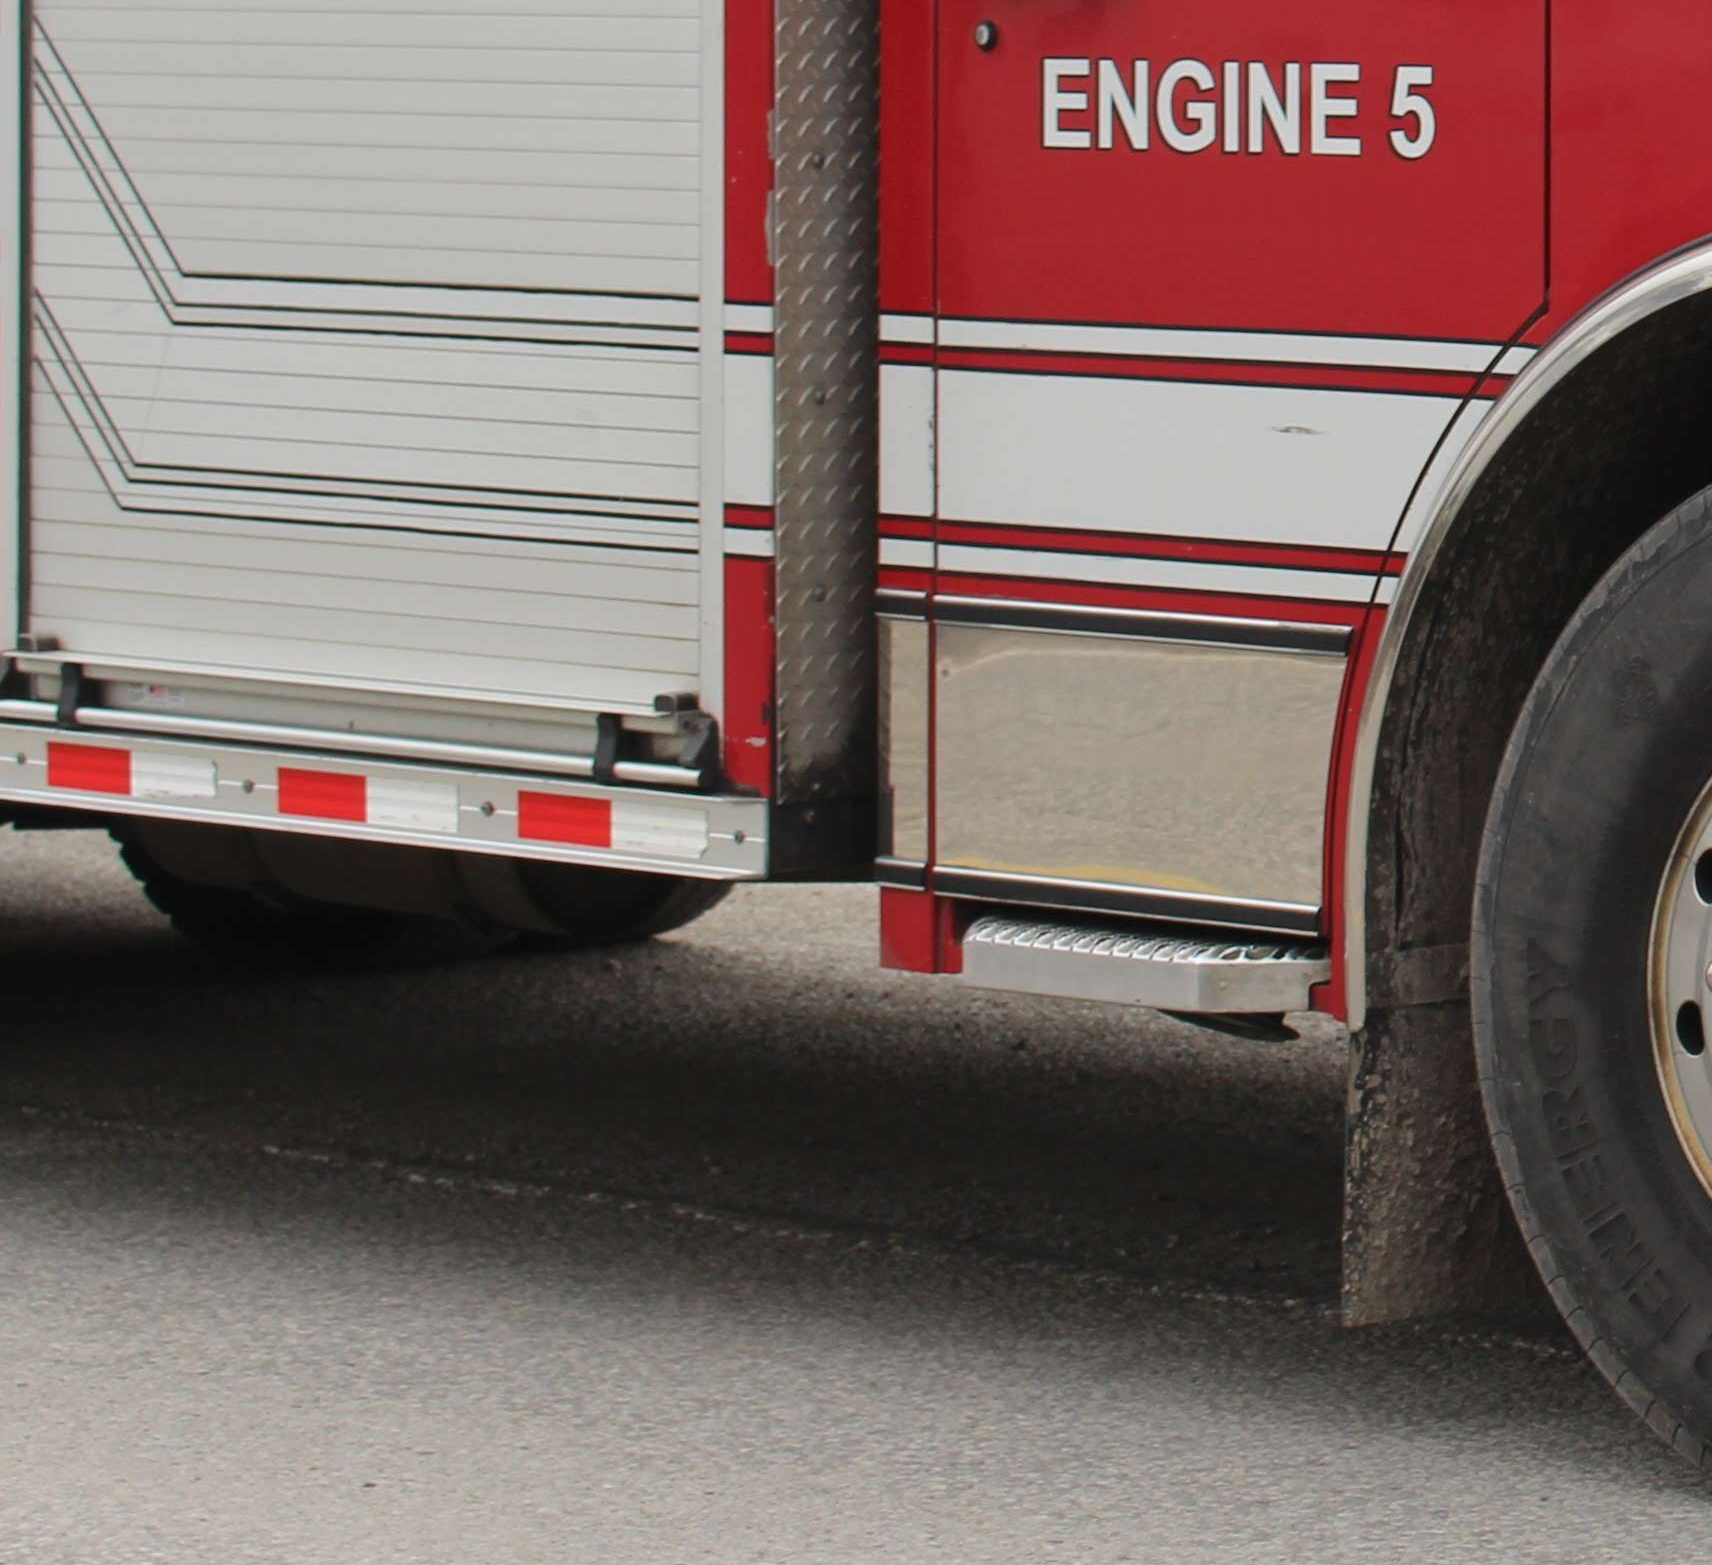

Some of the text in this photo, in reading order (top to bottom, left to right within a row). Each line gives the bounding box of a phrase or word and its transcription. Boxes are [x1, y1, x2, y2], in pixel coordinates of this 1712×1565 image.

[1041, 56, 1437, 159] ENGINE 5
[1526, 939, 1692, 1341] ENERGY
